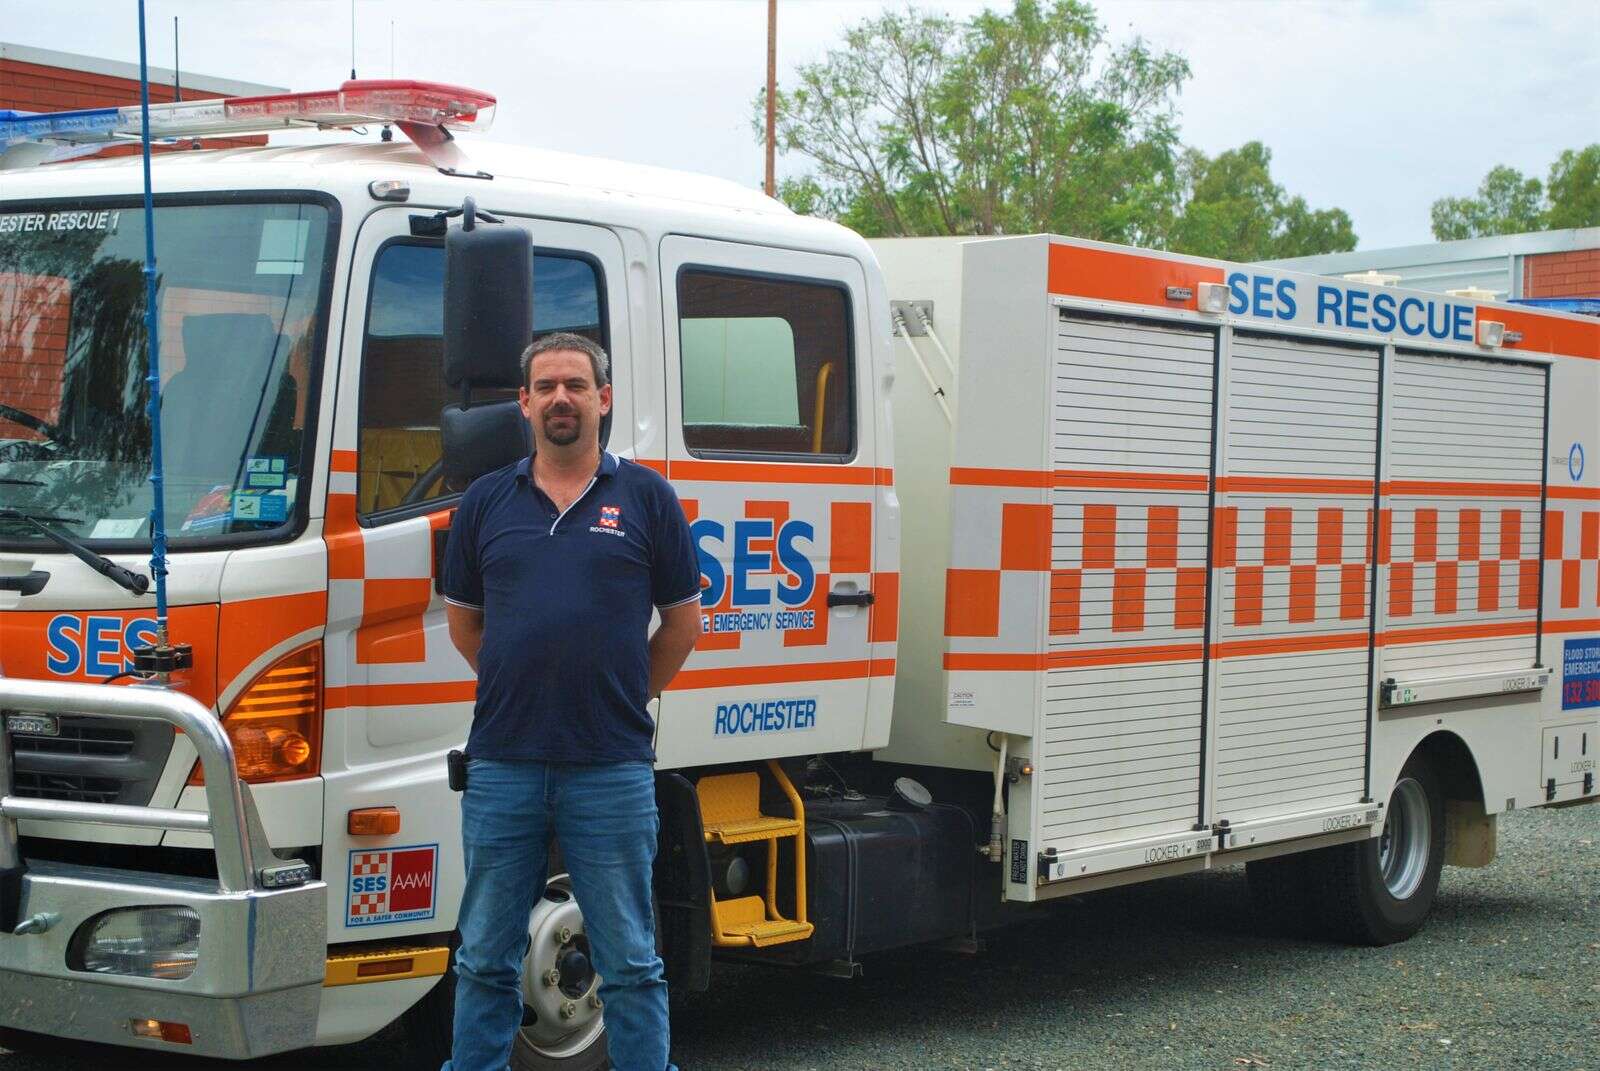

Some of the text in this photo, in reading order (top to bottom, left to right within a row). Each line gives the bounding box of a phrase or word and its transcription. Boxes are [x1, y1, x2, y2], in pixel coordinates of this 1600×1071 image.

[0, 210, 120, 232] ESTER RESCUE 1
[1228, 272, 1474, 342] SES RESCUE
[590, 526, 625, 537] ROCHESTER
[689, 519, 816, 608] SES
[714, 612, 773, 632] EMERGENCY
[775, 610, 815, 630] SERVICE
[1565, 648, 1584, 661] FLOOD
[1564, 681, 1583, 704] 132
[715, 699, 816, 735] ROCHESTER
[1322, 814, 1351, 831] LOCKER
[1144, 844, 1179, 863] LOCKER
[353, 876, 387, 893] SES
[392, 870, 431, 891] AAMI
[394, 910, 430, 920] COMMUNITY
